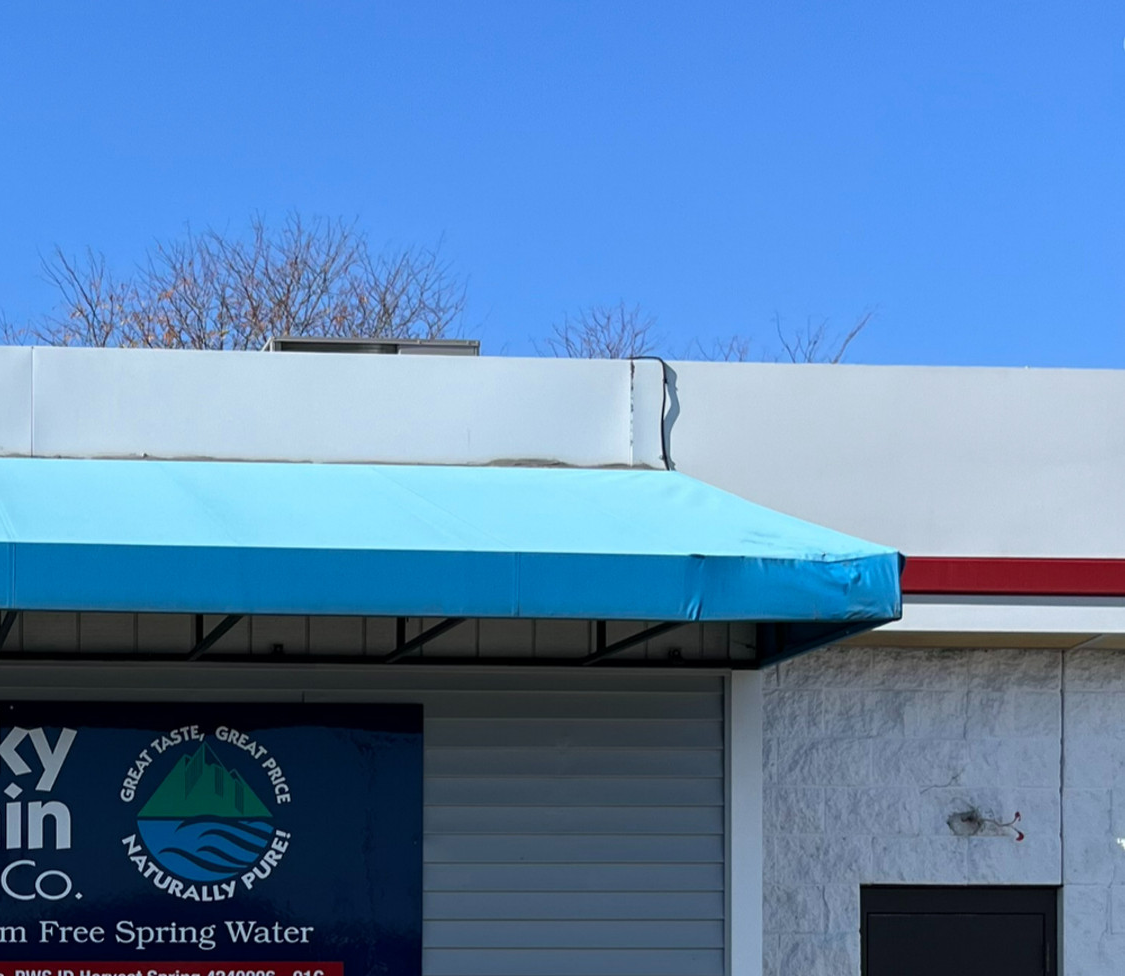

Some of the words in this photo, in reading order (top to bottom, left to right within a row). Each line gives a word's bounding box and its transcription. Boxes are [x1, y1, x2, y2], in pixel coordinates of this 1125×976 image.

[120, 750, 153, 802] GREAT
[150, 725, 205, 753] TASTE,
[215, 726, 267, 759] GREAT
[262, 757, 291, 804] PRICE
[0, 859, 83, 901] Co.
[121, 834, 236, 901] NATURALLY
[241, 829, 291, 890] PURE!
[39, 920, 105, 943] Free
[115, 920, 216, 950] Spring
[224, 921, 314, 943] Water
